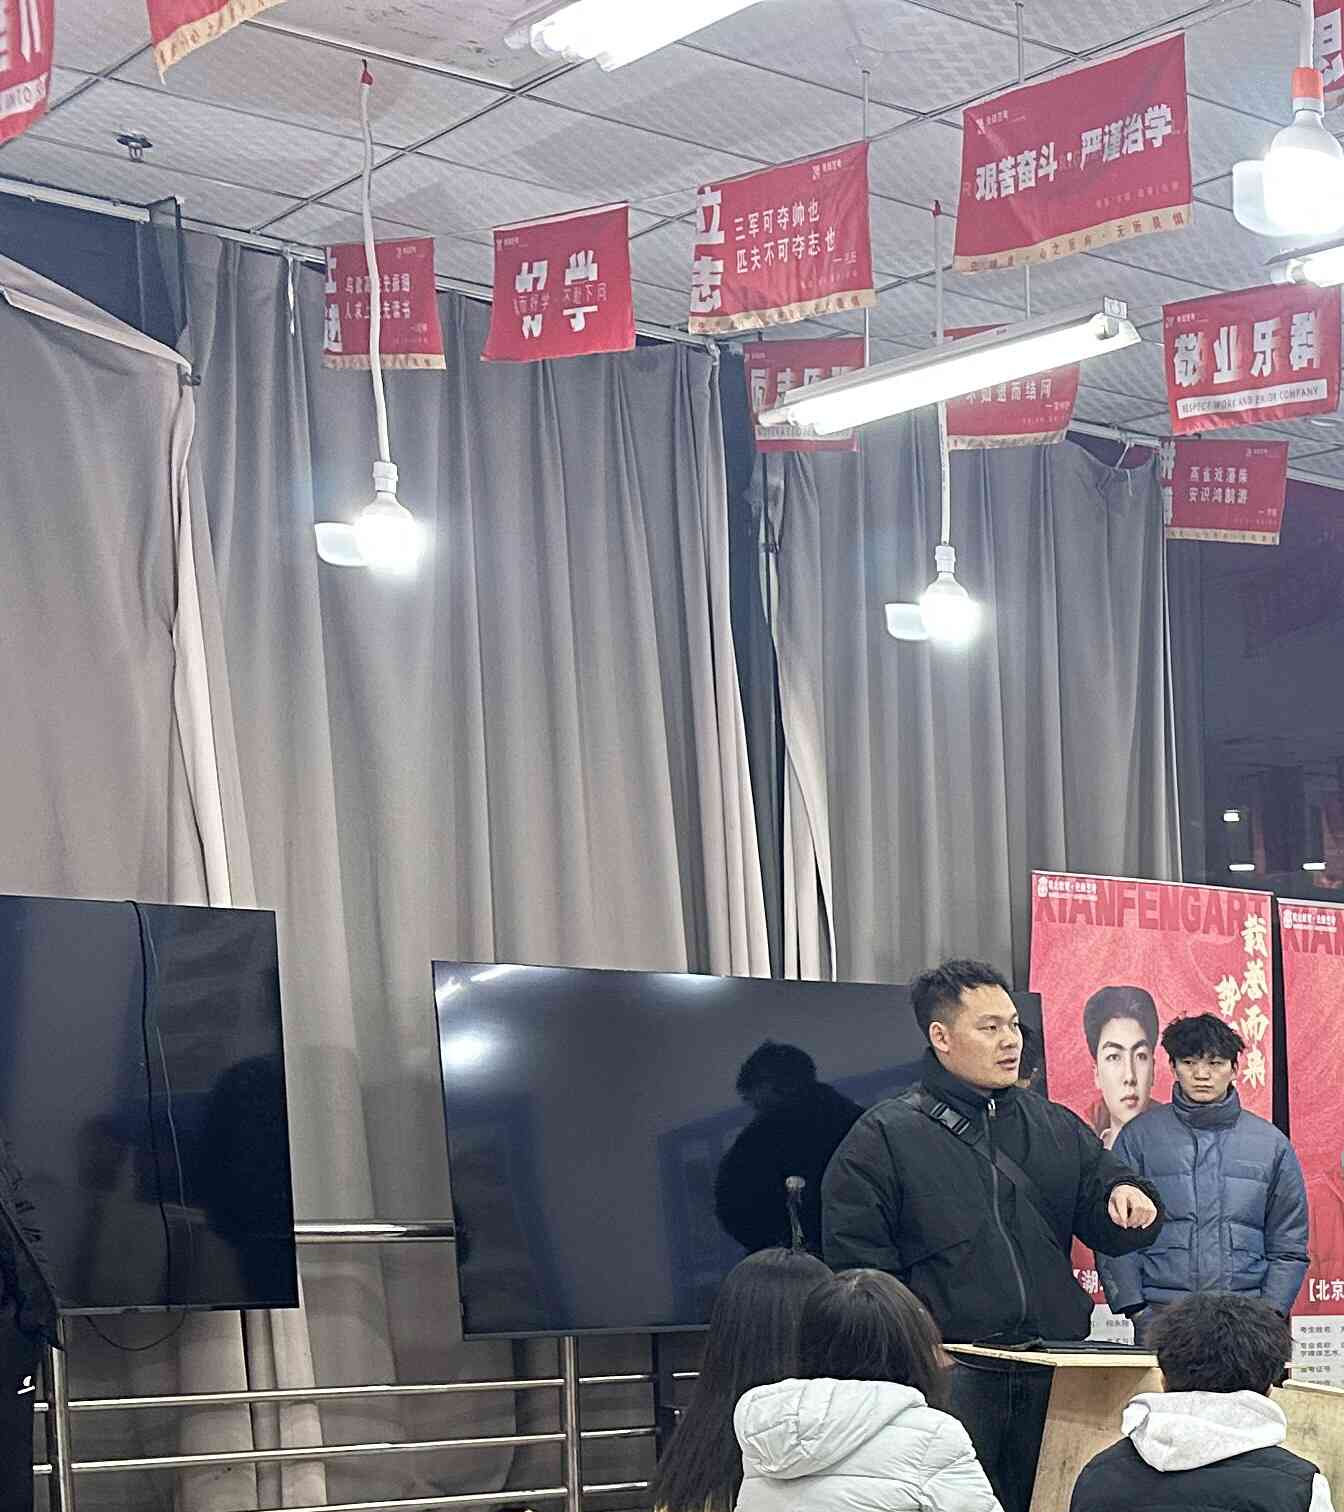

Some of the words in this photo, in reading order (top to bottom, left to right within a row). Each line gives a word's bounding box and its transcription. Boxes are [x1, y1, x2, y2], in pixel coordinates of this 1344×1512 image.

[975, 103, 1173, 201] 艰苦奋斗·严谨治学
[734, 197, 820, 241] 三军可夺帅也
[736, 226, 837, 274] 匹夫不可夺志也
[1174, 310, 1321, 388] 敬业乐群
